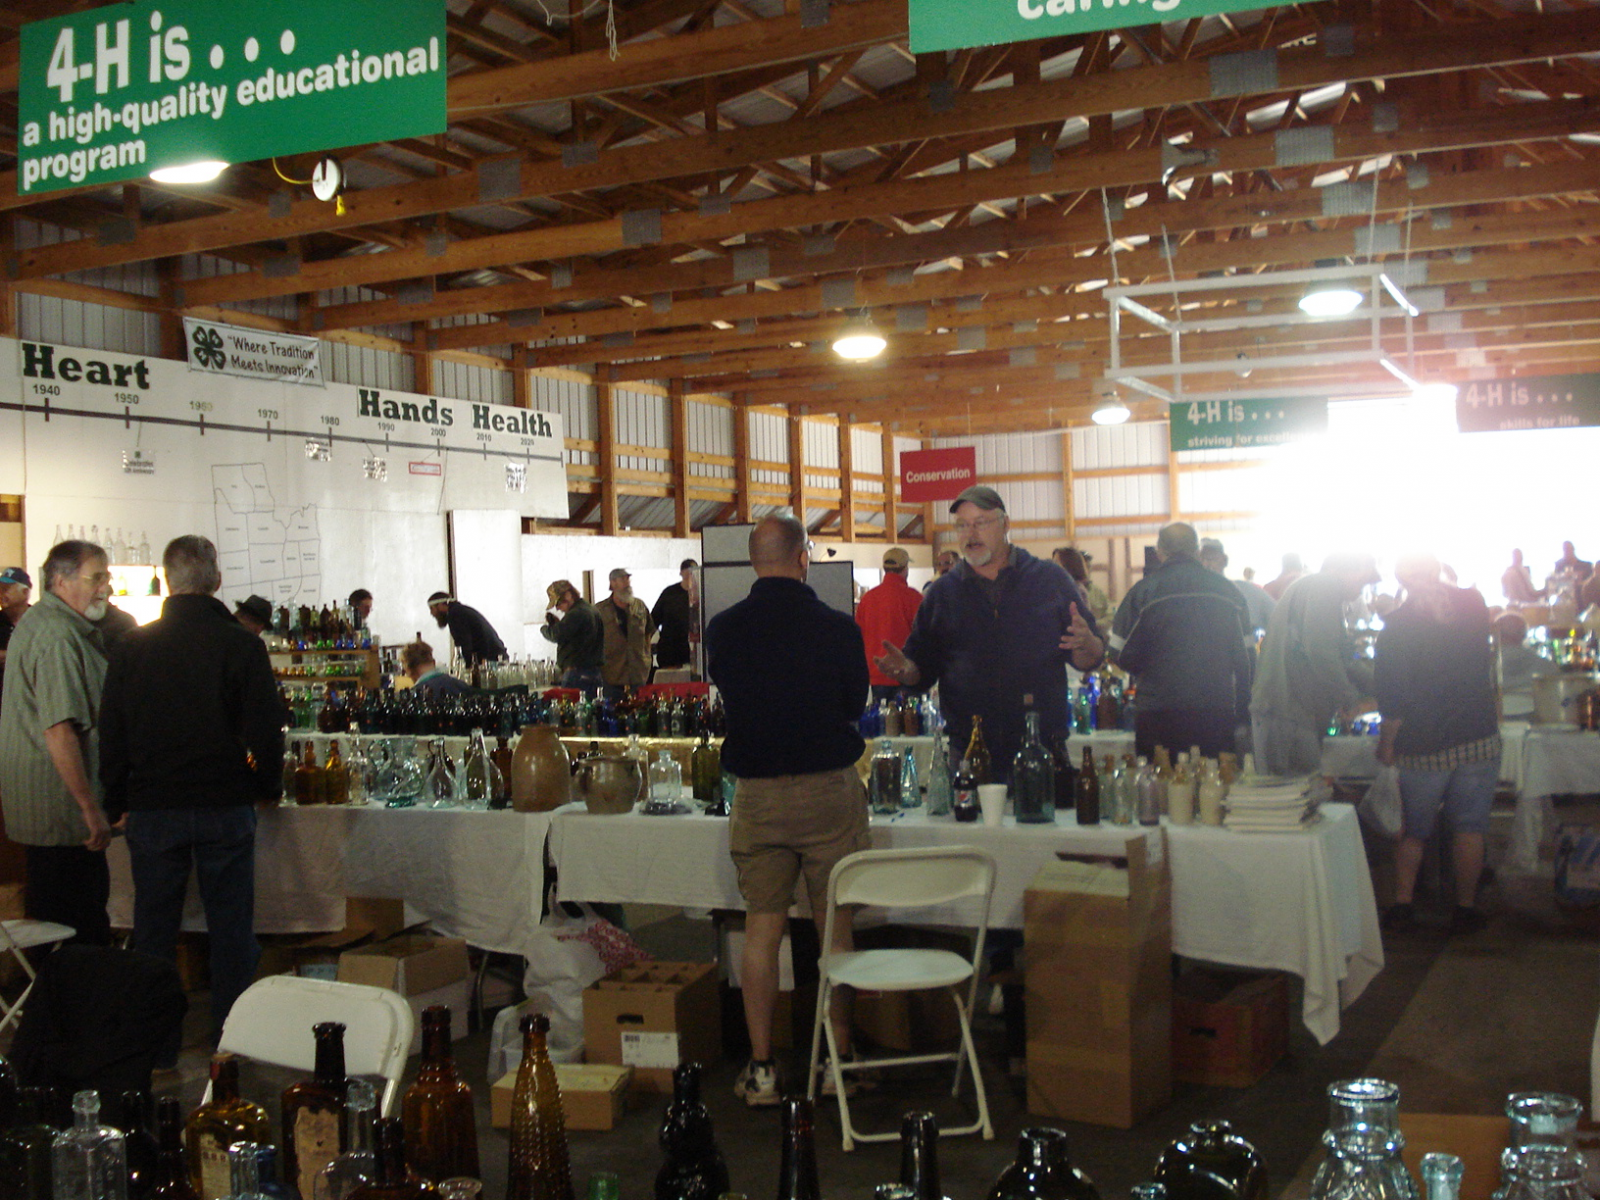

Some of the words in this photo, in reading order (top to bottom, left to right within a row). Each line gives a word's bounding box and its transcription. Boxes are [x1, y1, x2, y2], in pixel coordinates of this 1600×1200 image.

[46, 18, 130, 103] 4-H
[149, 10, 191, 84] is
[22, 121, 40, 146] a
[49, 82, 228, 143] high-quality
[236, 36, 440, 106] educational
[22, 139, 147, 191] program
[269, 341, 315, 361] Tradition
[22, 343, 150, 391] Heart
[230, 354, 264, 373] Meets
[32, 384, 61, 396] 1940
[1466, 383, 1503, 409] 4-H
[1511, 381, 1530, 405] is
[114, 392, 139, 405] 1950
[258, 408, 279, 420] 1970
[320, 415, 340, 427] 1980
[358, 389, 453, 427] Hands
[472, 404, 552, 438] Health
[1187, 400, 1222, 426] 4-H
[1227, 400, 1246, 423] is
[377, 422, 395, 432] 1990
[1500, 418, 1535, 431] skills
[1536, 416, 1556, 428] for
[430, 427, 447, 438] 2000
[476, 432, 492, 443] 2010
[520, 437, 535, 446] 2020
[1187, 434, 1233, 448] striving
[906, 467, 971, 484] Conservation
